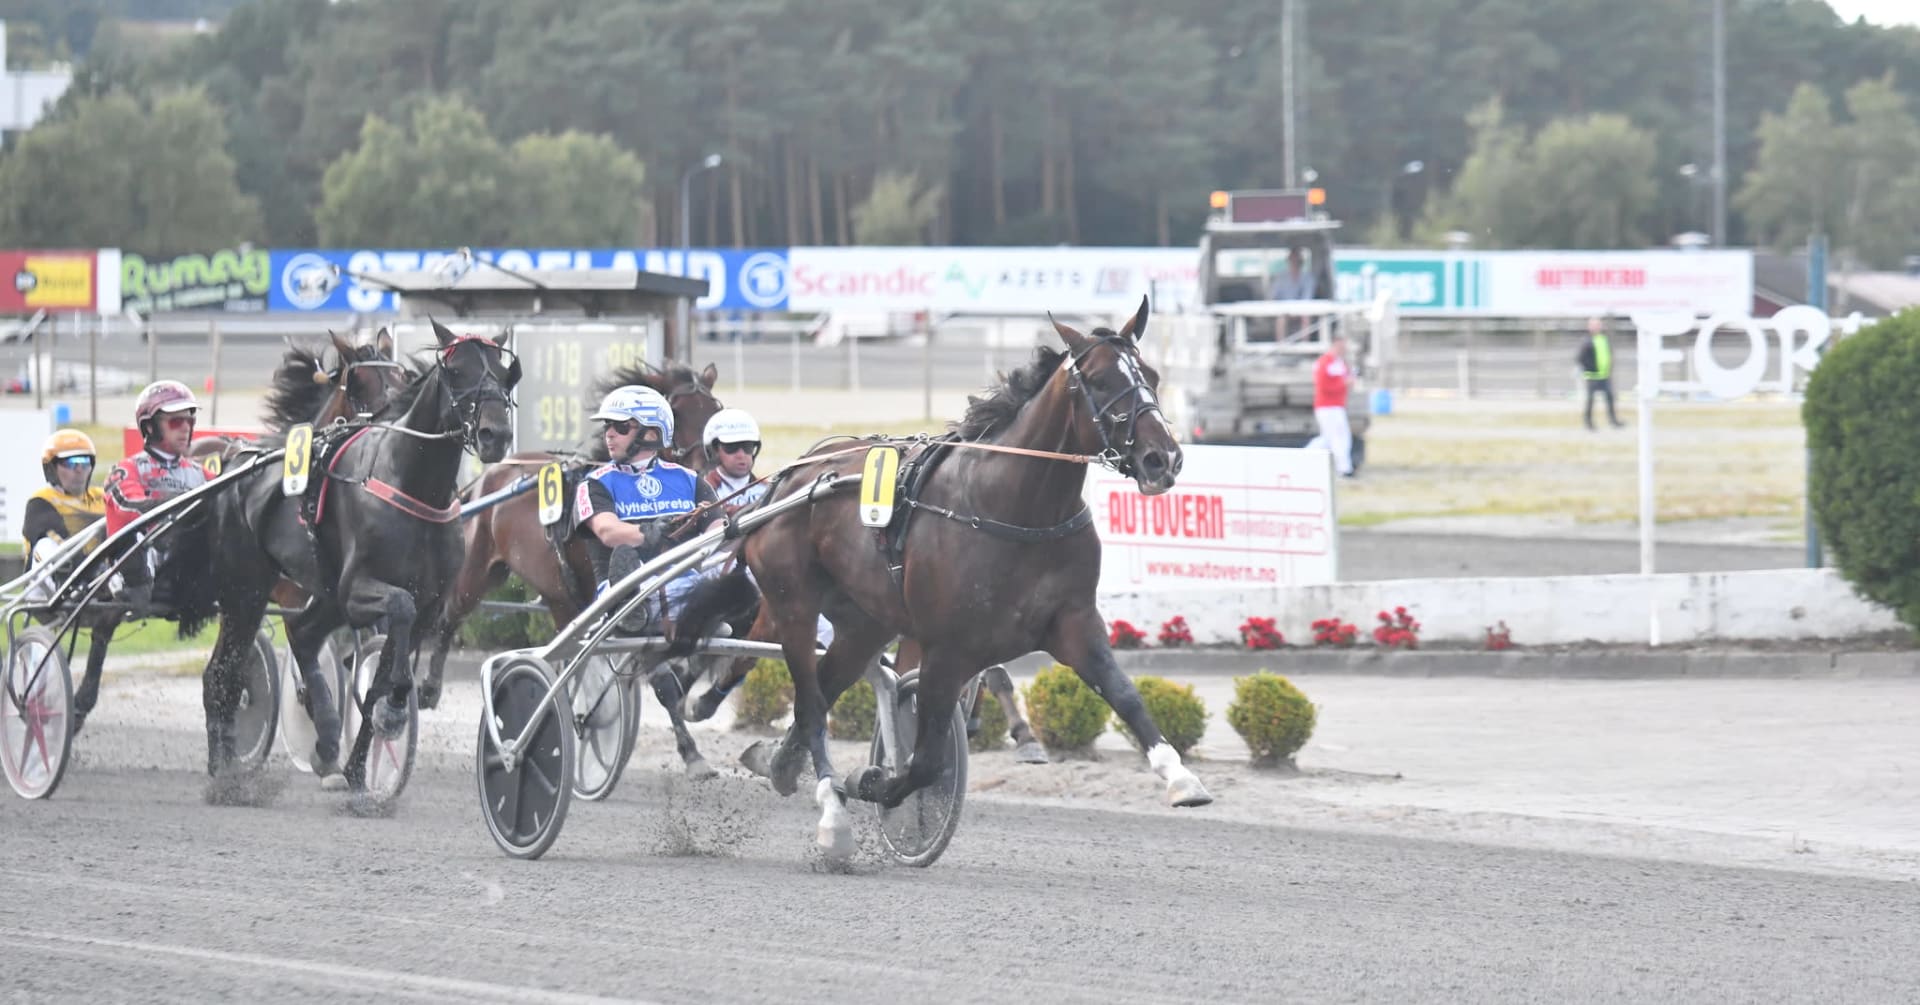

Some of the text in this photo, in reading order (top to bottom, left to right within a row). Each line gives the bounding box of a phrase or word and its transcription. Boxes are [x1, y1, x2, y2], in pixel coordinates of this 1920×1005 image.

[794, 265, 934, 297] Scandic
[540, 395, 582, 441] 999
[289, 429, 306, 475] 3
[544, 466, 557, 506] 6
[873, 450, 886, 503] 1
[1109, 491, 1224, 540] AUTOVERN
[1146, 561, 1277, 583] www.autovern.no
